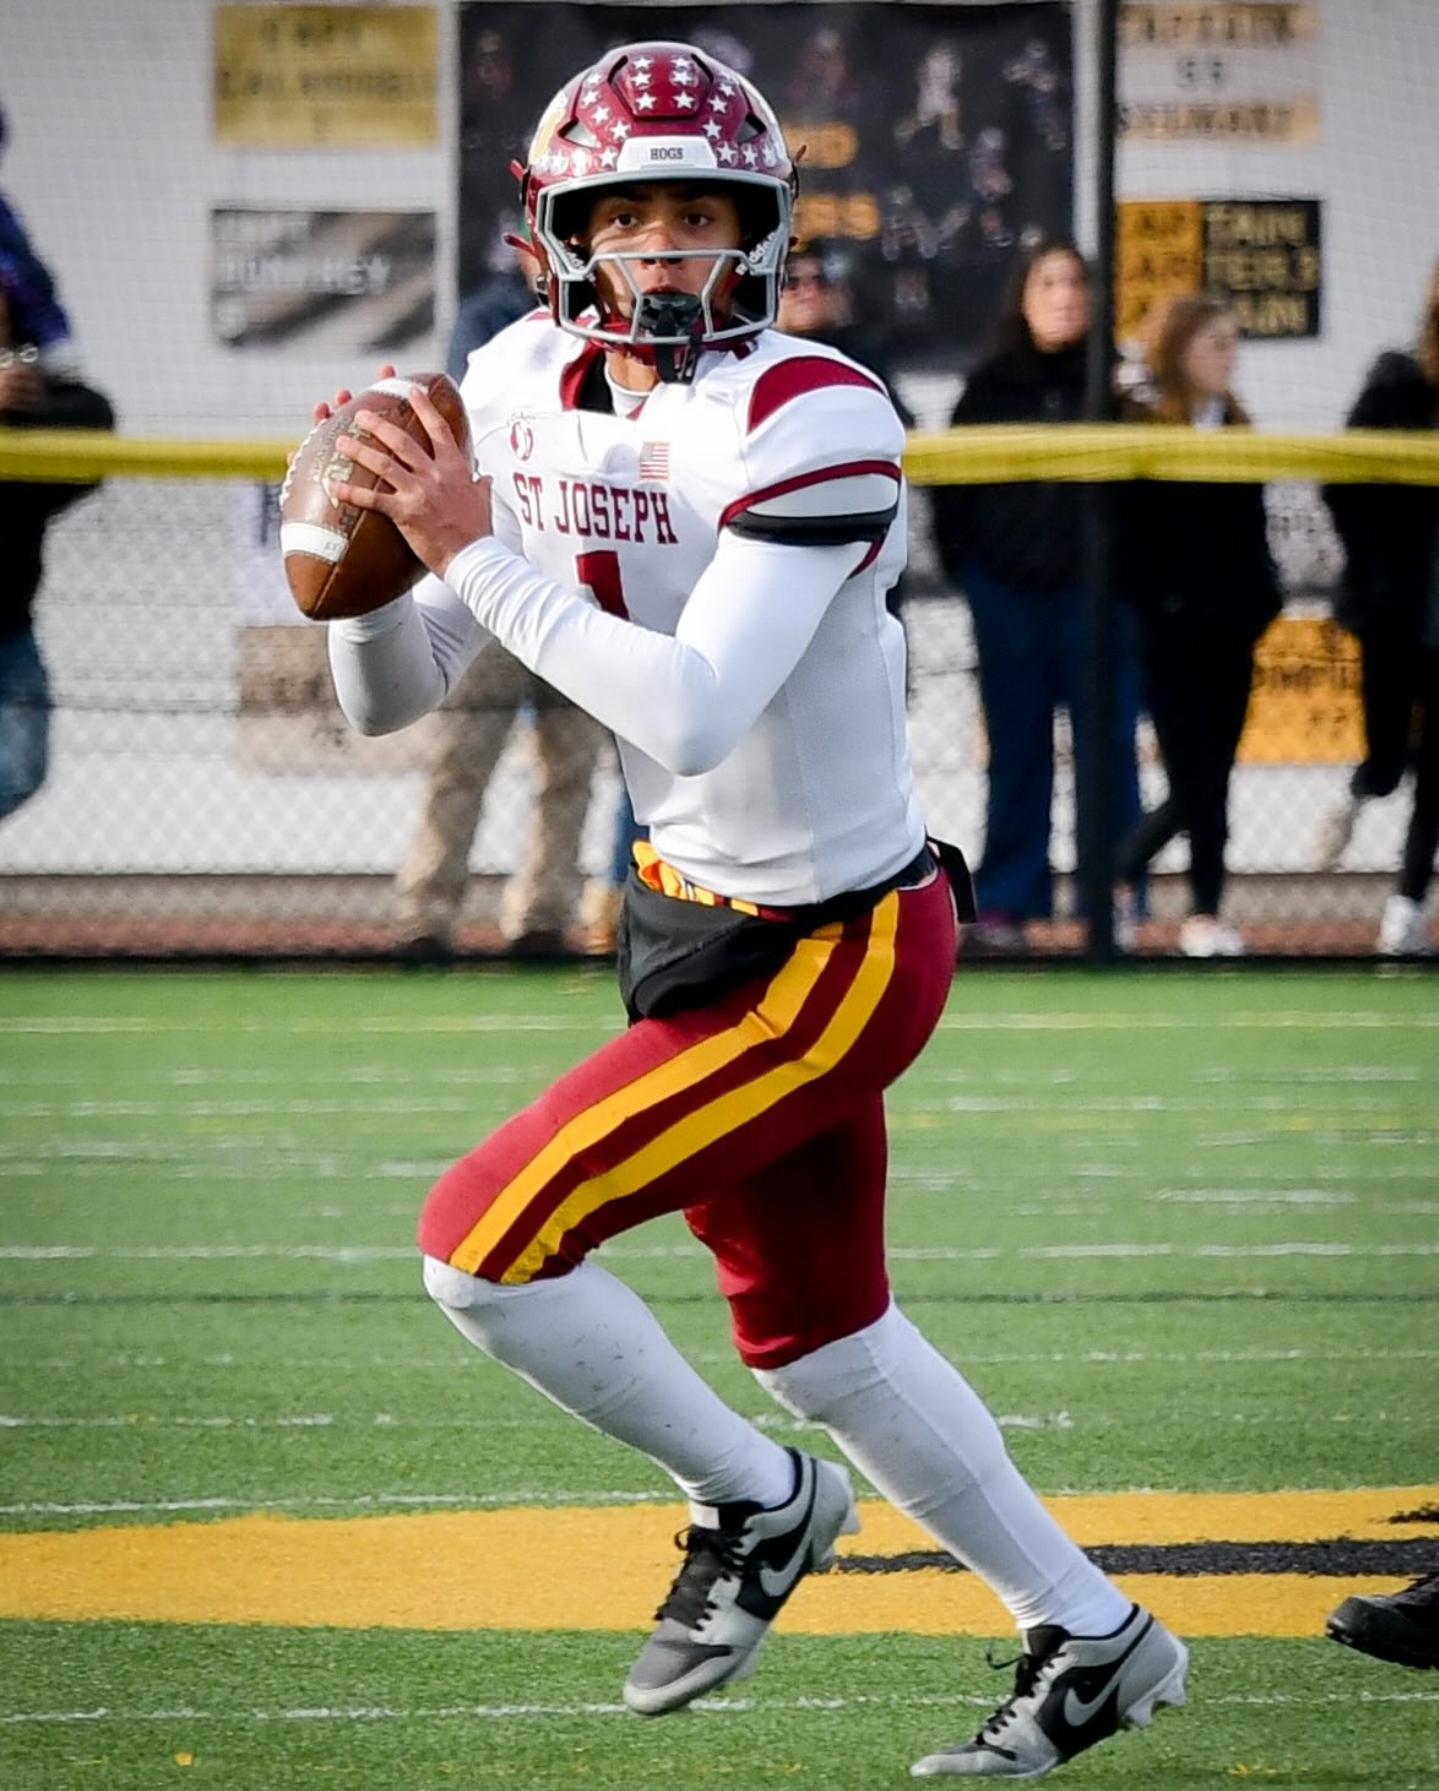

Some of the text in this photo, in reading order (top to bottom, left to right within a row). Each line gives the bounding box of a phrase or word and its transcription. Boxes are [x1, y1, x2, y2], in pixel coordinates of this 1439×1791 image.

[649, 147, 684, 161] HOGS
[512, 471, 679, 545] ST JOSEPH
